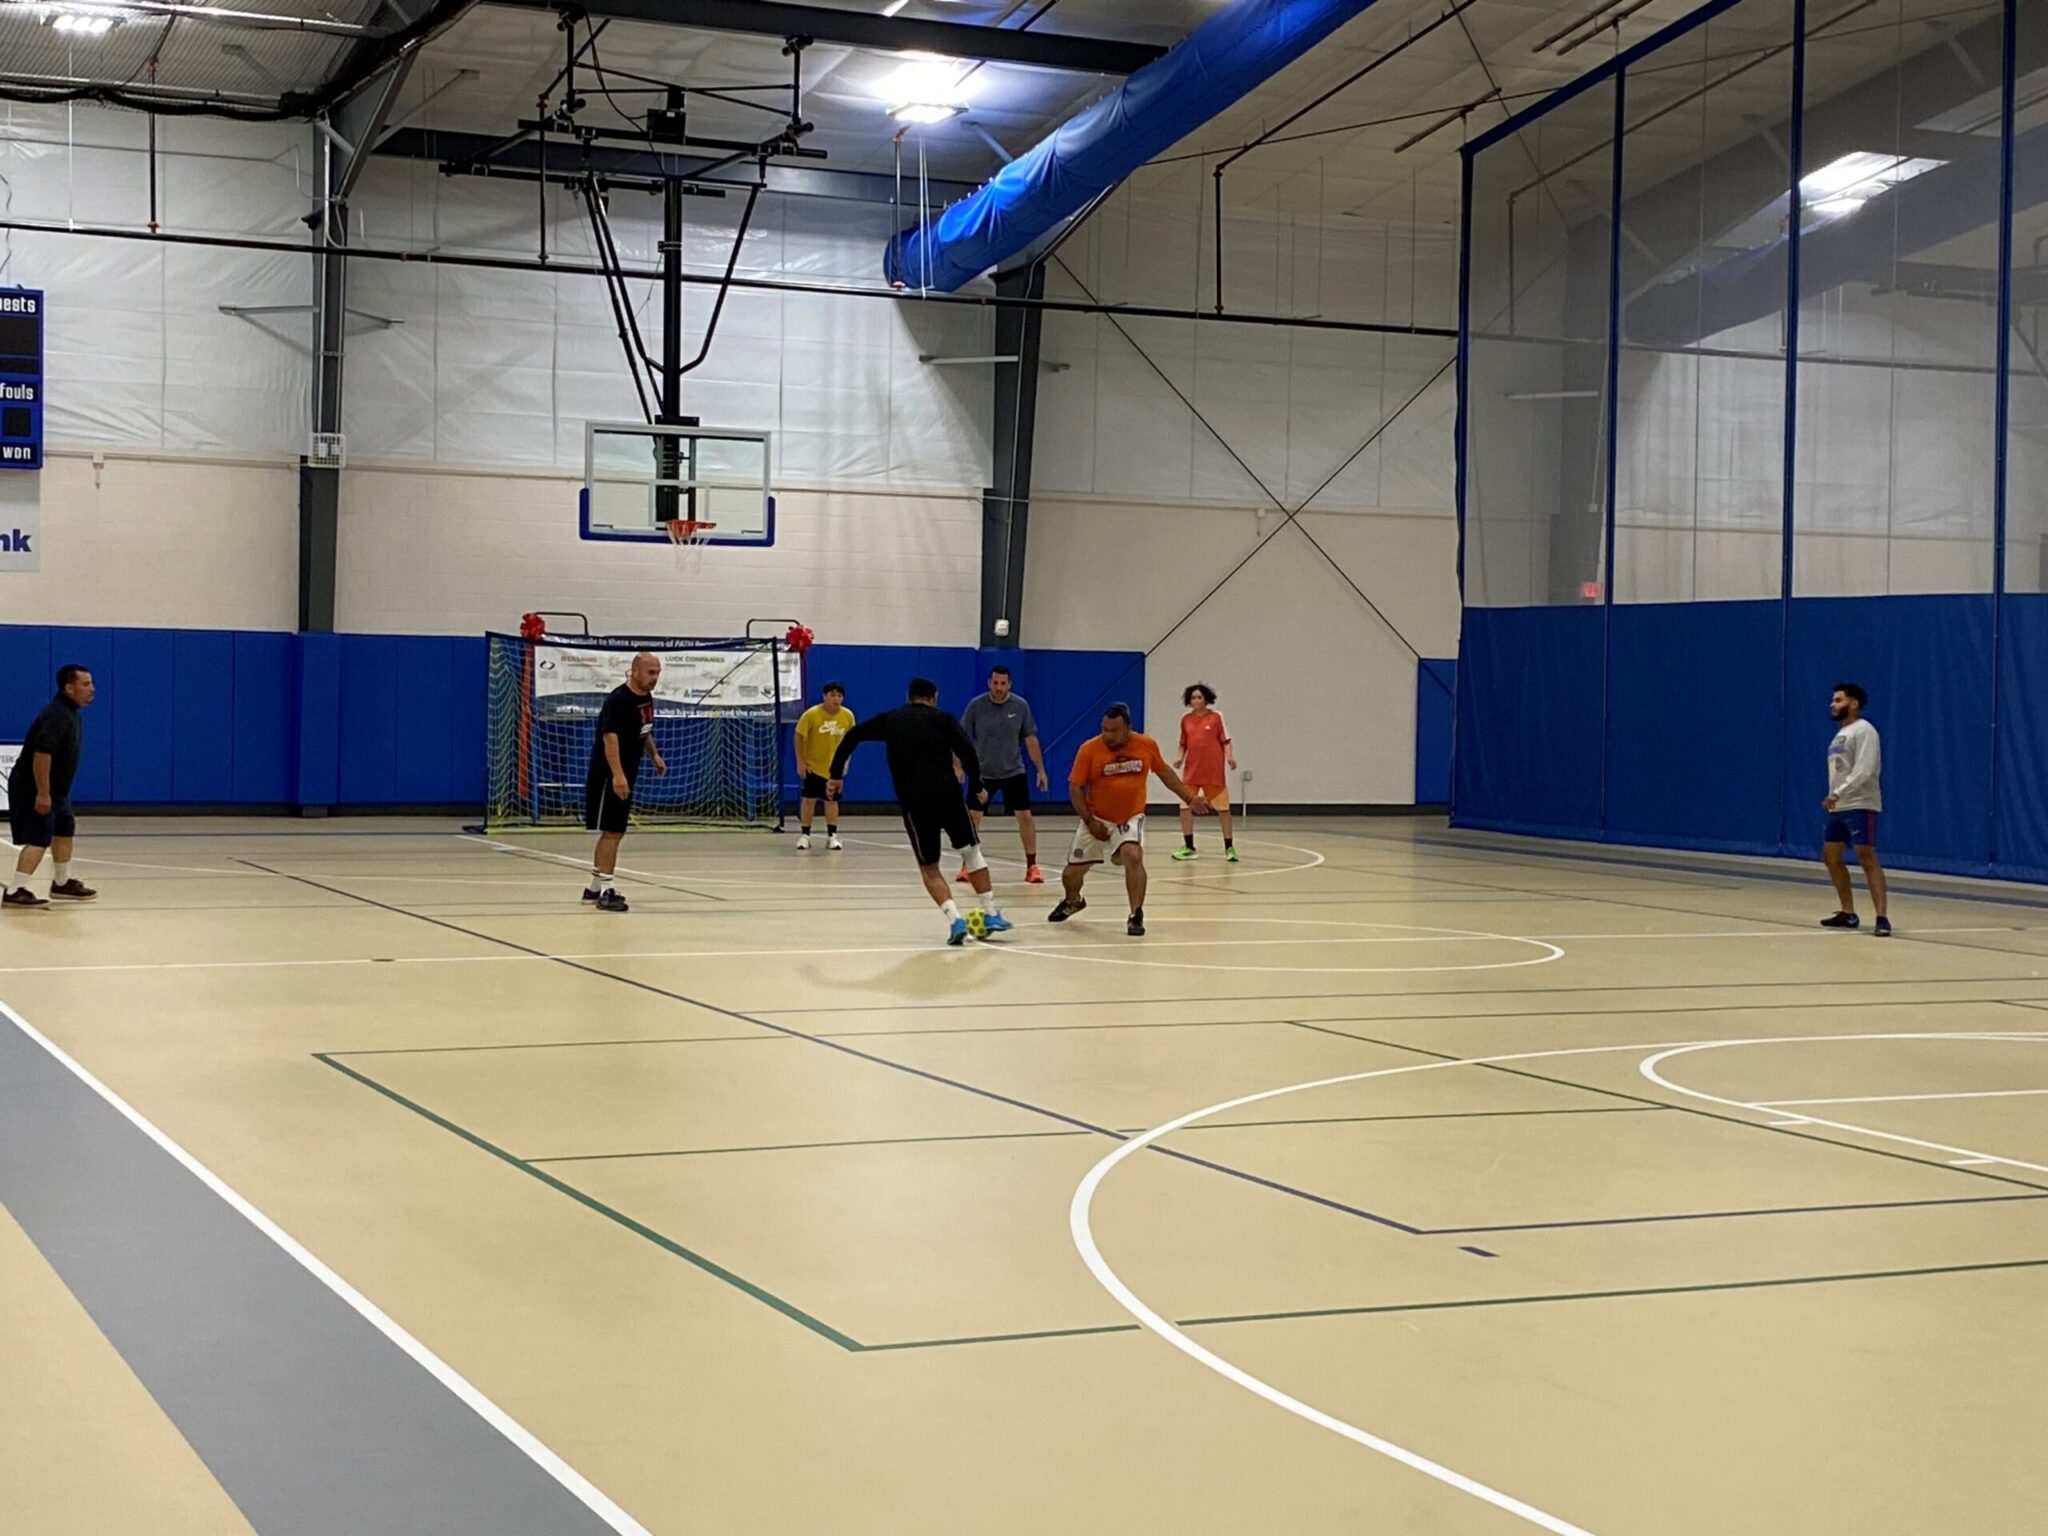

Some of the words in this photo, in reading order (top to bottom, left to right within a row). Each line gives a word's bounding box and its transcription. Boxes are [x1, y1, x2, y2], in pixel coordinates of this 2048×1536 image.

[0, 297, 36, 313] ests
[0, 382, 34, 400] fouls
[2, 446, 31, 460] won
[608, 636, 629, 647] these
[630, 638, 664, 649] sponsors
[665, 639, 673, 648] of
[674, 639, 694, 648] PATH
[685, 656, 725, 664] COMPANIES
